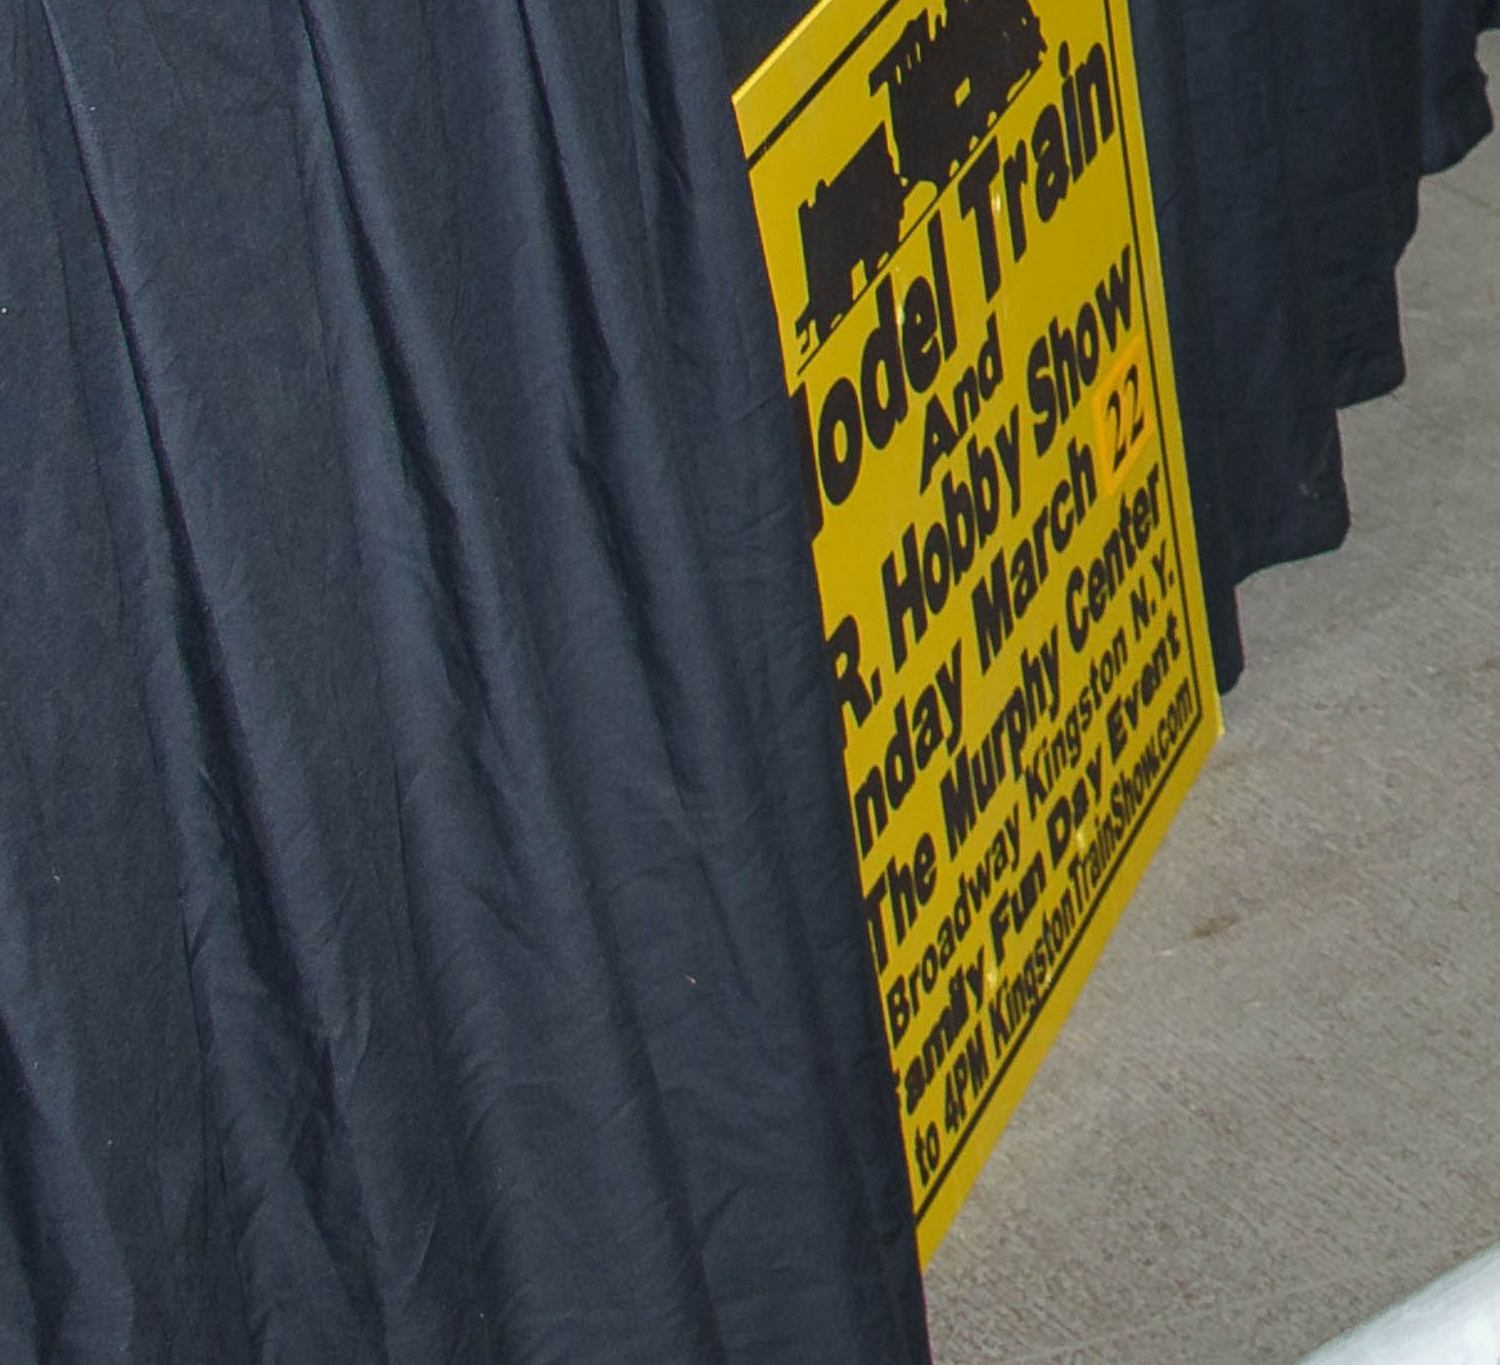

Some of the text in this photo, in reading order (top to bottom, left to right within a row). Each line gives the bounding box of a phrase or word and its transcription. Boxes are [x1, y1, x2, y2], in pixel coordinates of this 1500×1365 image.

[919, 312, 1004, 495] And
[957, 40, 1116, 304] Train
[852, 364, 1146, 862] nday March 22
[881, 405, 1021, 673] Hobby
[1027, 244, 1132, 458] Show
[864, 463, 1161, 974] The Murphy Center
[886, 803, 1020, 1050] Broadway
[1025, 626, 1128, 821] Kingston
[897, 609, 1180, 1116] amily Fun Day Event
[915, 676, 1193, 1188] to 4PM KingstonTrainShow.com
